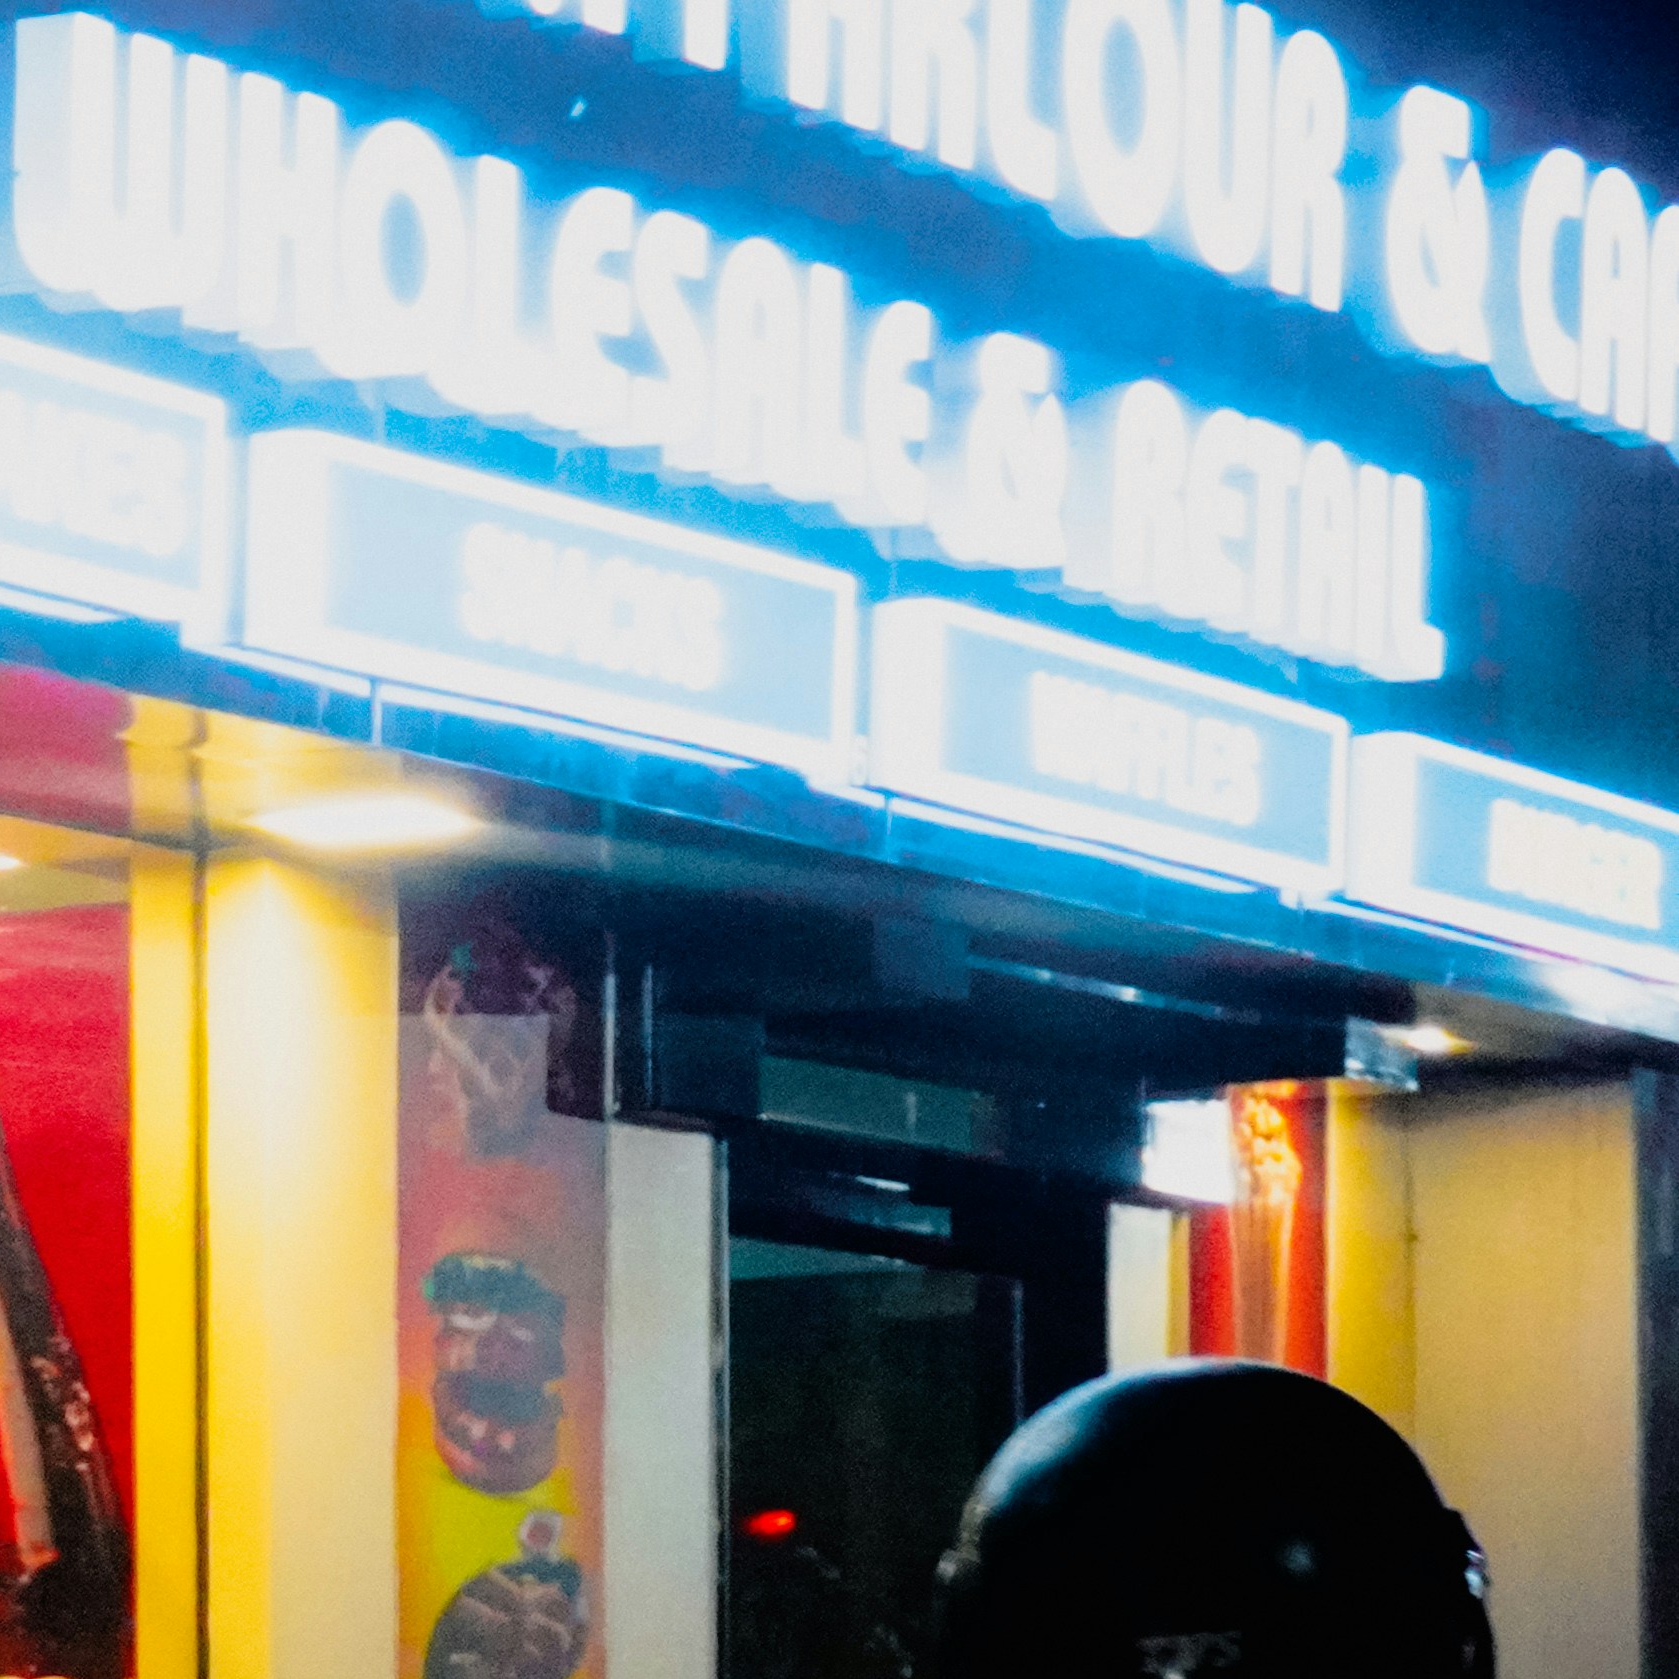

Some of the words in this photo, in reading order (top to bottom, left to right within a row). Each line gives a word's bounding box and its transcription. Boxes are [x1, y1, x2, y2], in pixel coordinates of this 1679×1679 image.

[9, 10, 935, 527] WHOLESALE
[965, 330, 1070, 568] &
[1109, 378, 1446, 681] RETAIL
[683, 0, 1349, 313] RLOUR
[1384, 82, 1491, 363] &
